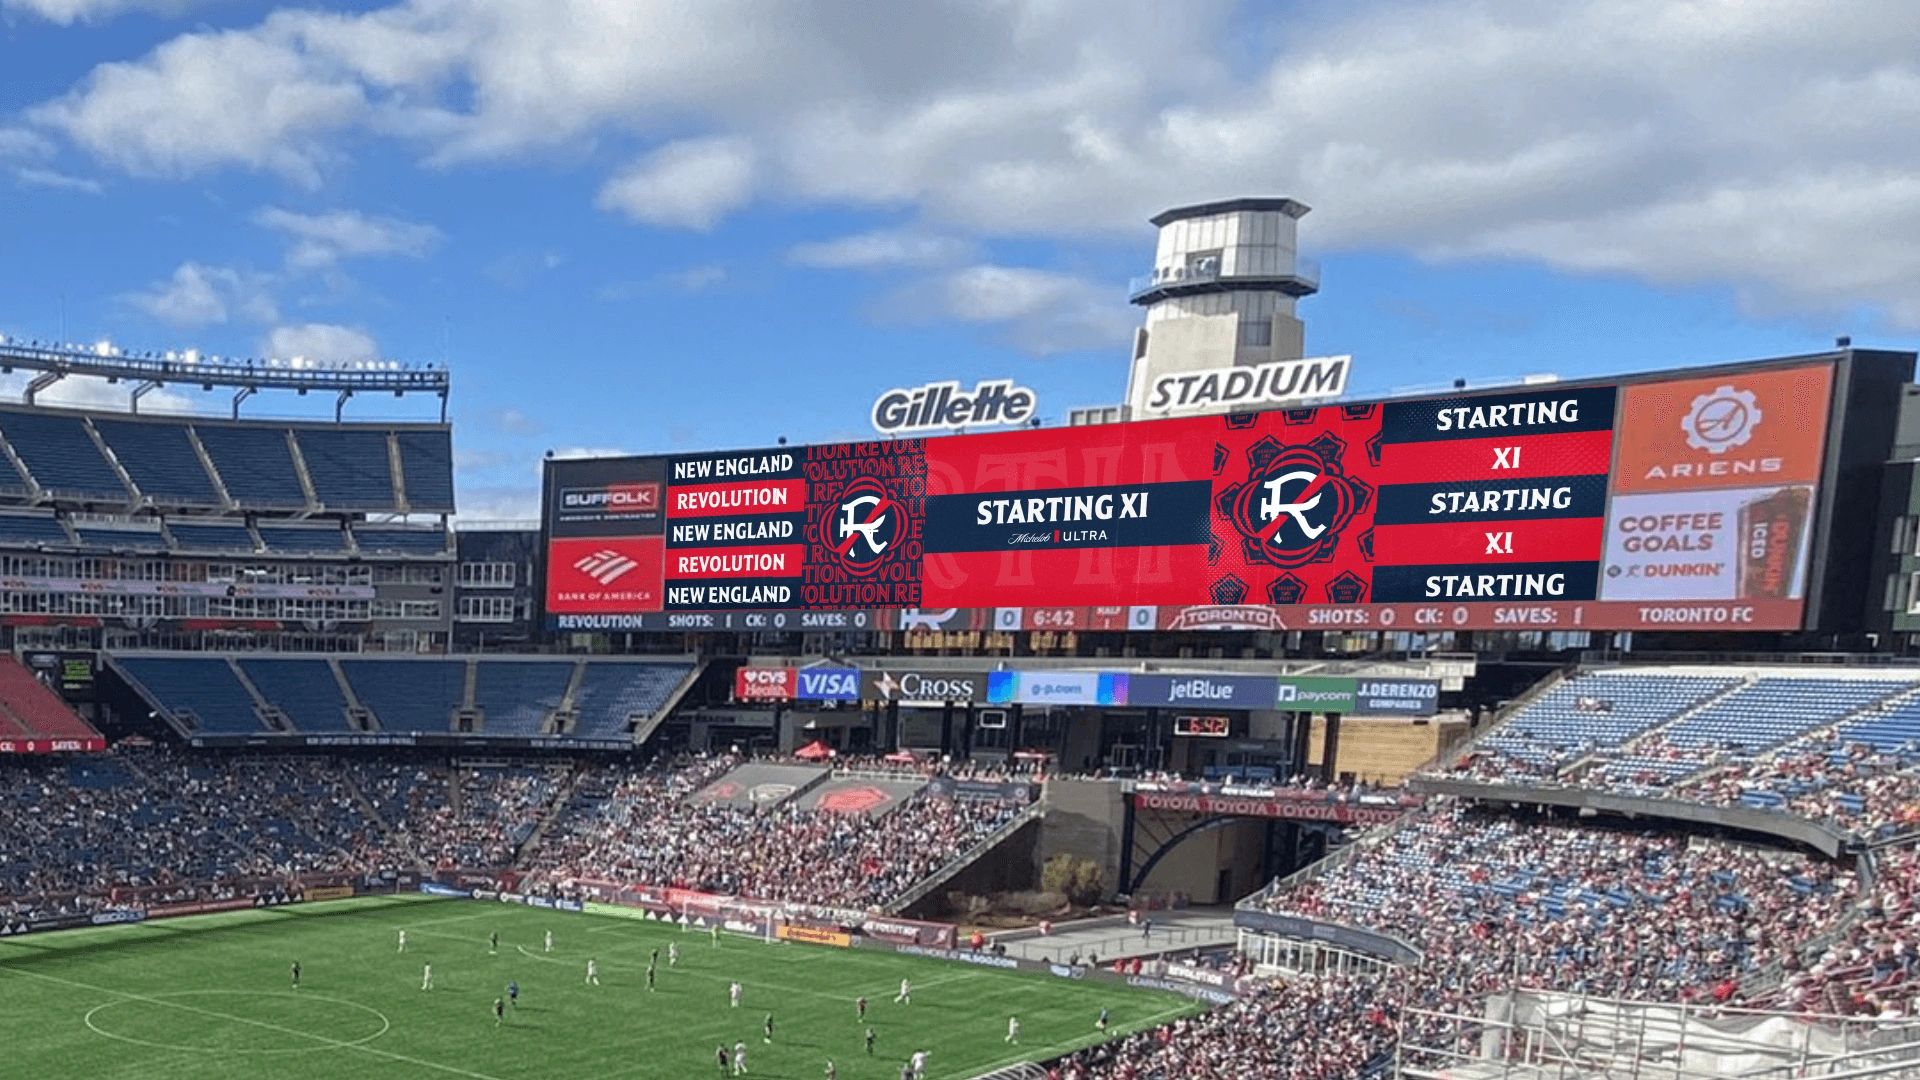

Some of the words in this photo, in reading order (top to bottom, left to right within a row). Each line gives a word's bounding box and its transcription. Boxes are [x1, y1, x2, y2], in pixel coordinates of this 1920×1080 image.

[1150, 361, 1346, 409] STADIUM
[874, 384, 1032, 430] Gillette
[1436, 399, 1579, 431] STARTING
[675, 460, 713, 479] NEW
[716, 454, 793, 477] ENGLAND
[1491, 446, 1521, 470] XI
[1644, 457, 1784, 480] ARIENS
[564, 491, 651, 506] SUFFOLK
[677, 488, 788, 509] REVOLUTION
[977, 494, 1114, 526] STARTING
[1118, 492, 1149, 519] XI
[1429, 487, 1573, 515] STARTING
[673, 525, 711, 542] NEW
[713, 521, 794, 541] ENGLAND
[1618, 512, 1724, 533] COFFEE
[1008, 531, 1053, 545] Michelob
[1063, 530, 1108, 542] ULTRA
[1485, 531, 1513, 555] XI
[1622, 533, 1715, 554] GOALS
[1751, 522, 1769, 559] ICED
[678, 553, 786, 573] REVOLUTION
[558, 592, 585, 601] BANK
[588, 592, 601, 601] OF
[603, 592, 651, 601] AMERICA
[668, 587, 705, 604] NEW
[708, 586, 791, 603] ENGLAND
[1425, 573, 1566, 599] STARTING
[558, 615, 643, 628] REVOLUTION
[668, 615, 715, 627] SHOTS:
[745, 614, 767, 627] CK:
[774, 613, 786, 627] 0
[801, 614, 847, 627] SAVES:
[854, 613, 866, 627] 0
[1002, 610, 1015, 626] 0
[1033, 609, 1075, 626] 6:42
[1136, 609, 1149, 625] 0
[1187, 609, 1269, 623] TORONTO
[1308, 609, 1369, 624] SHOTS:
[1379, 608, 1395, 625] 0
[1414, 608, 1443, 624] CK:
[1452, 607, 1468, 625] 0
[1493, 607, 1558, 624] SAVES:
[1638, 607, 1726, 622] TORONTO
[1731, 607, 1754, 622] FC
[758, 671, 787, 684] CVS
[801, 673, 857, 695] VISA
[901, 673, 974, 697] CROSS
[744, 683, 789, 697] Health
[1169, 679, 1235, 701] jetBlue
[1296, 689, 1352, 703] paycom
[1369, 699, 1422, 709] COMPANIES
[1142, 794, 1200, 810] TOYOTA
[1205, 799, 1269, 816] TOYOTA
[1275, 803, 1338, 820] TOYOTA
[1346, 808, 1401, 821] TOYOT
